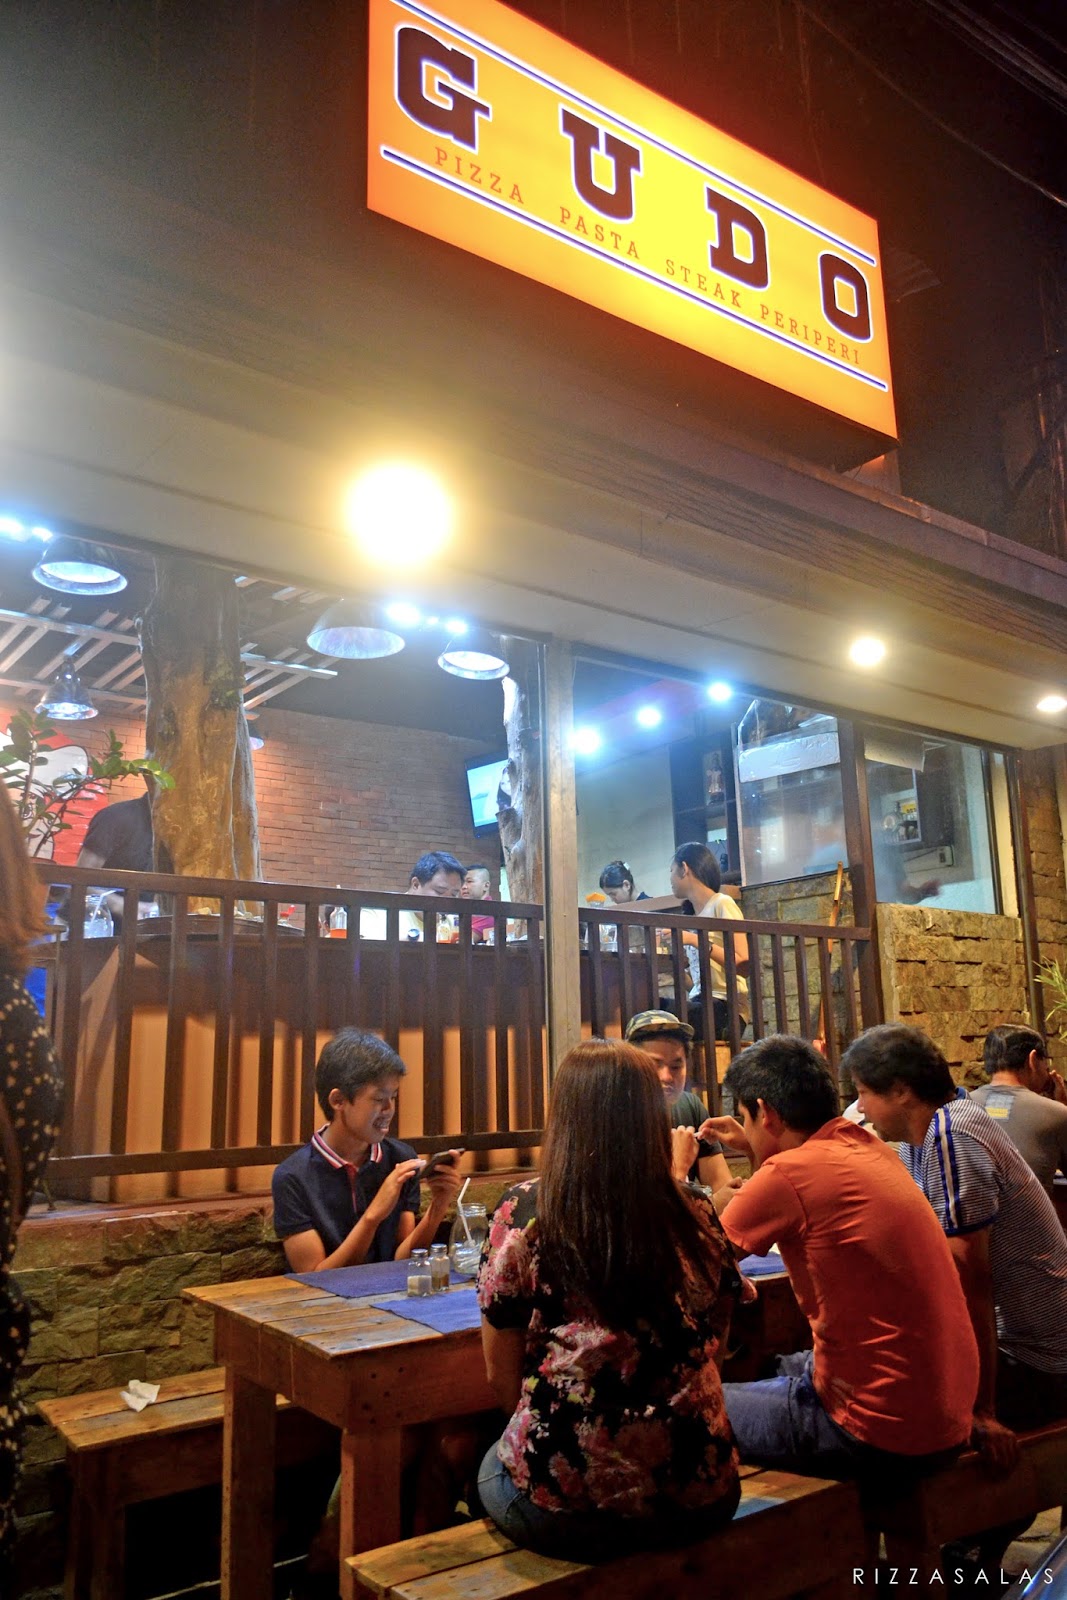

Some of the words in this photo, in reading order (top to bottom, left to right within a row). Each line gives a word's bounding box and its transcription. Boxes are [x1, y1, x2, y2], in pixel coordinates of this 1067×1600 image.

[397, 26, 872, 342] GUDO
[434, 146, 525, 205] PIZZA
[558, 205, 640, 260] PASTA
[665, 258, 742, 309] STEAK
[759, 303, 860, 365] PERIPERI
